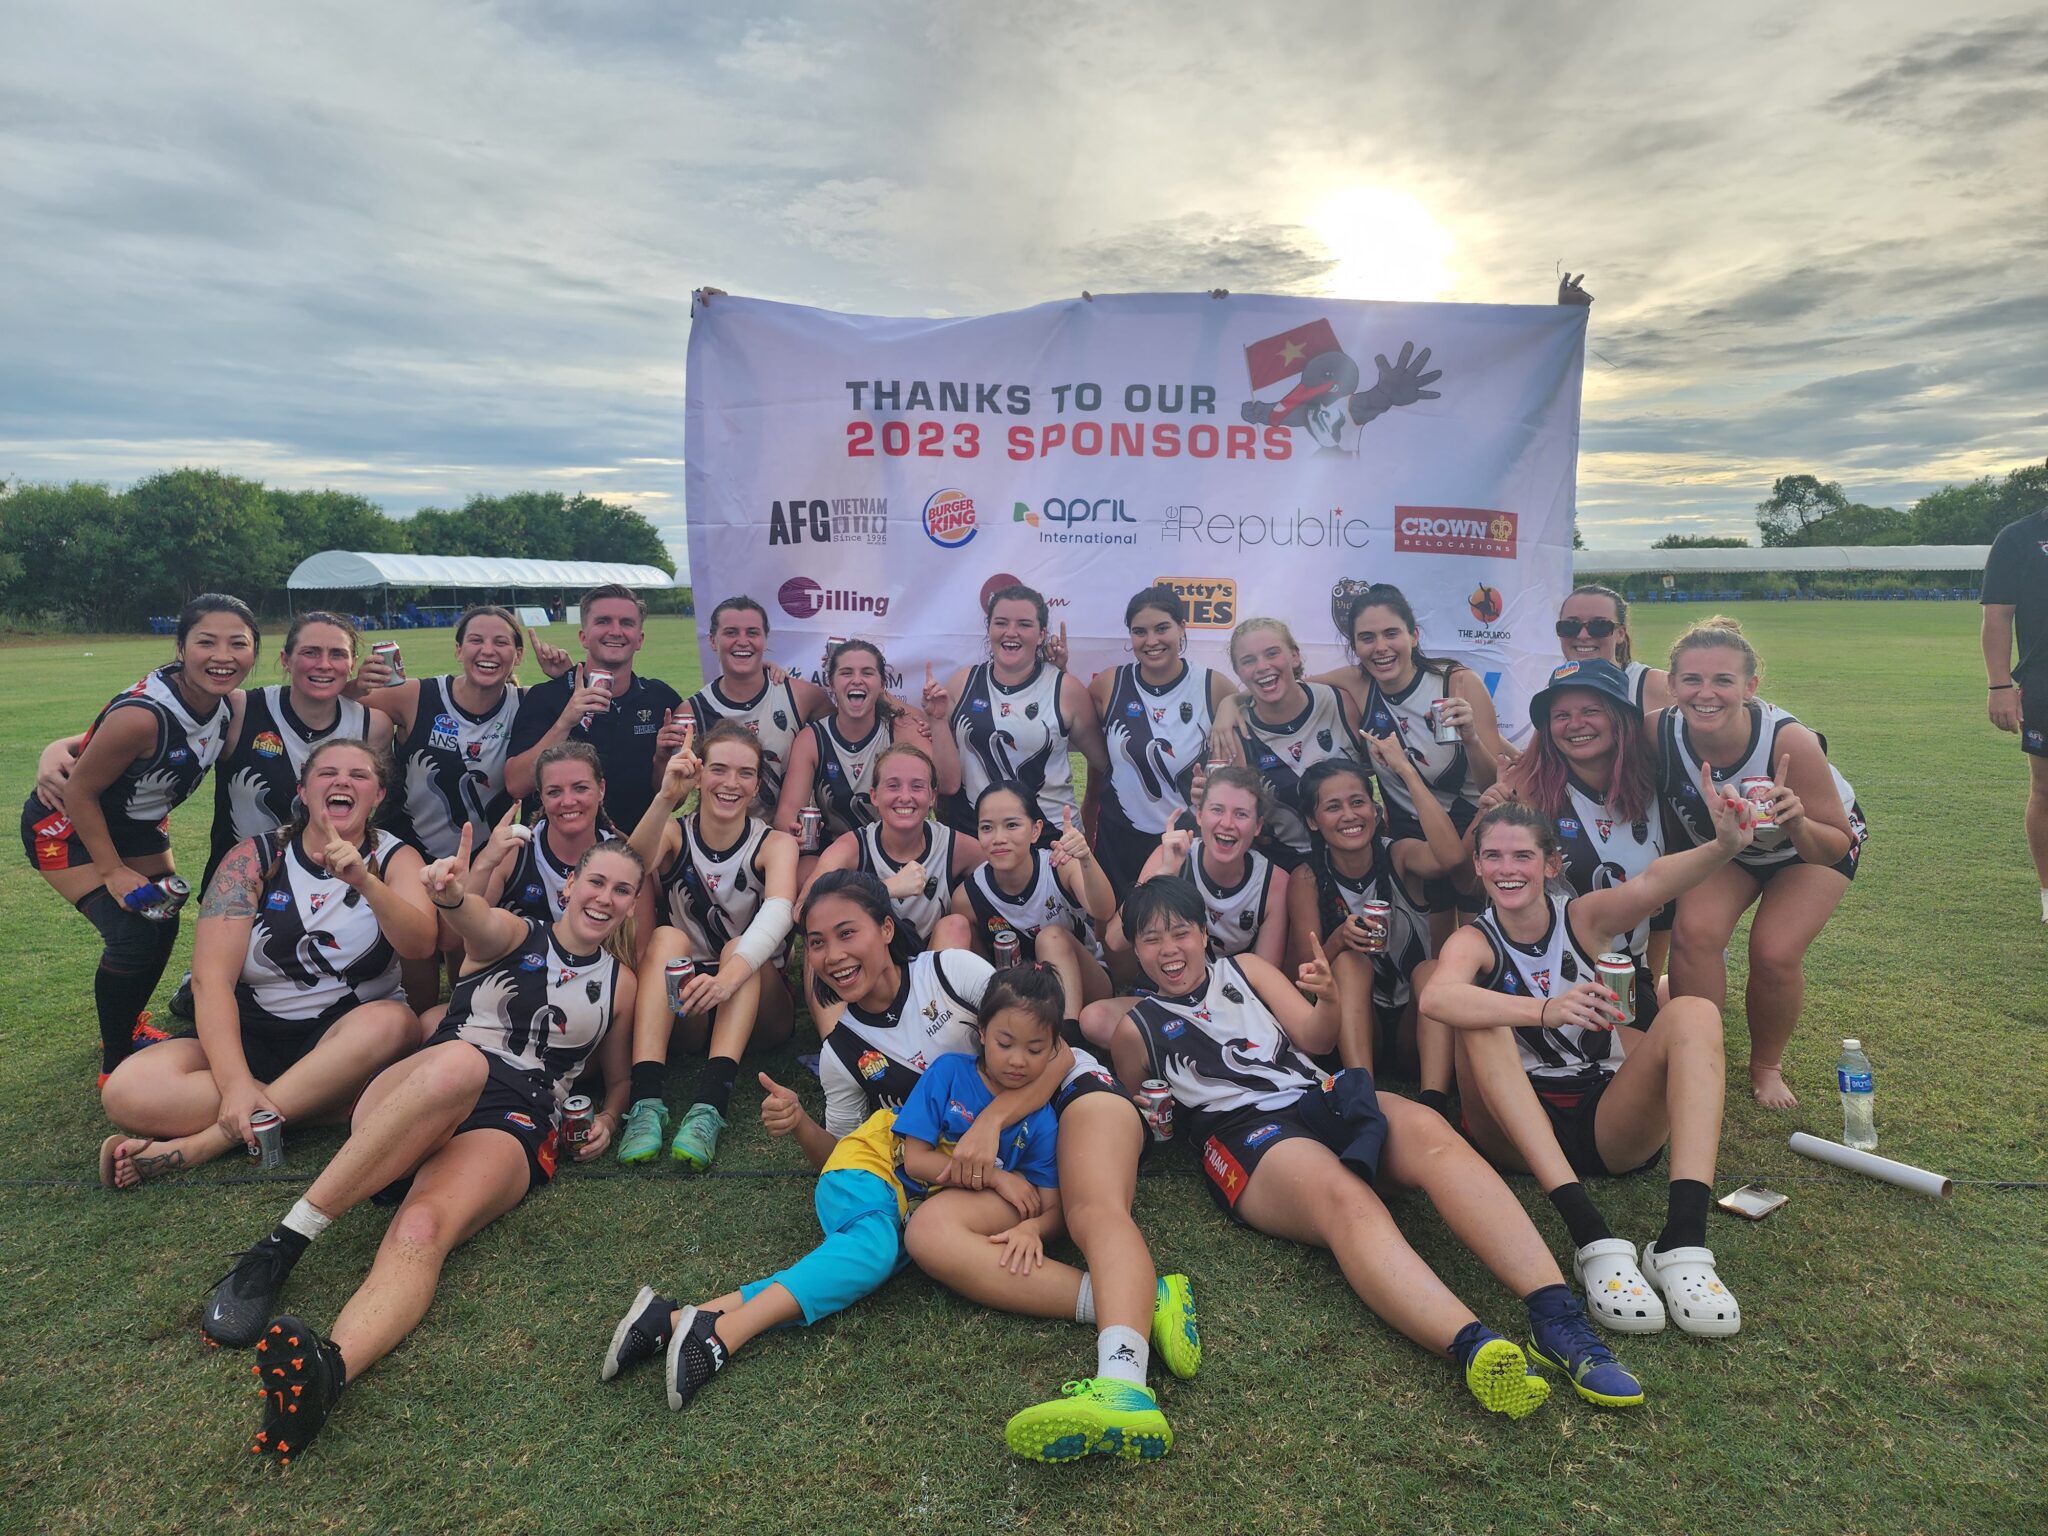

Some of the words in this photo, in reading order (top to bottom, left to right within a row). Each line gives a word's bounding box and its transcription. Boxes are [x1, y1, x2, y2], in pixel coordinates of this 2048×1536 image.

[846, 380, 1031, 415] THANKS
[1051, 382, 1102, 414] TO
[1124, 384, 1217, 415] OUR
[846, 421, 981, 458] 2023
[1007, 422, 1293, 461] SPONSORS
[831, 498, 888, 515] VIETNAM
[928, 499, 974, 521] BURGER
[768, 499, 831, 546] AFG
[930, 509, 976, 536] KING
[1162, 505, 1179, 542] The
[1179, 505, 1370, 553] Republic
[1400, 517, 1488, 539] CROWN
[867, 534, 887, 542] 1996
[1039, 531, 1137, 545] International
[1404, 539, 1510, 552] RELOCATIONS
[804, 588, 890, 617] Tilling
[1182, 600, 1233, 624] IES
[1458, 629, 1473, 639] THE
[1560, 820, 1579, 830] AFL
[270, 894, 290, 903] AFL
[926, 1010, 954, 1038] HALIDA
[1164, 1019, 1185, 1033] AFL
[705, 1335, 724, 1372] FILA
[1108, 1354, 1140, 1369] AKKA
